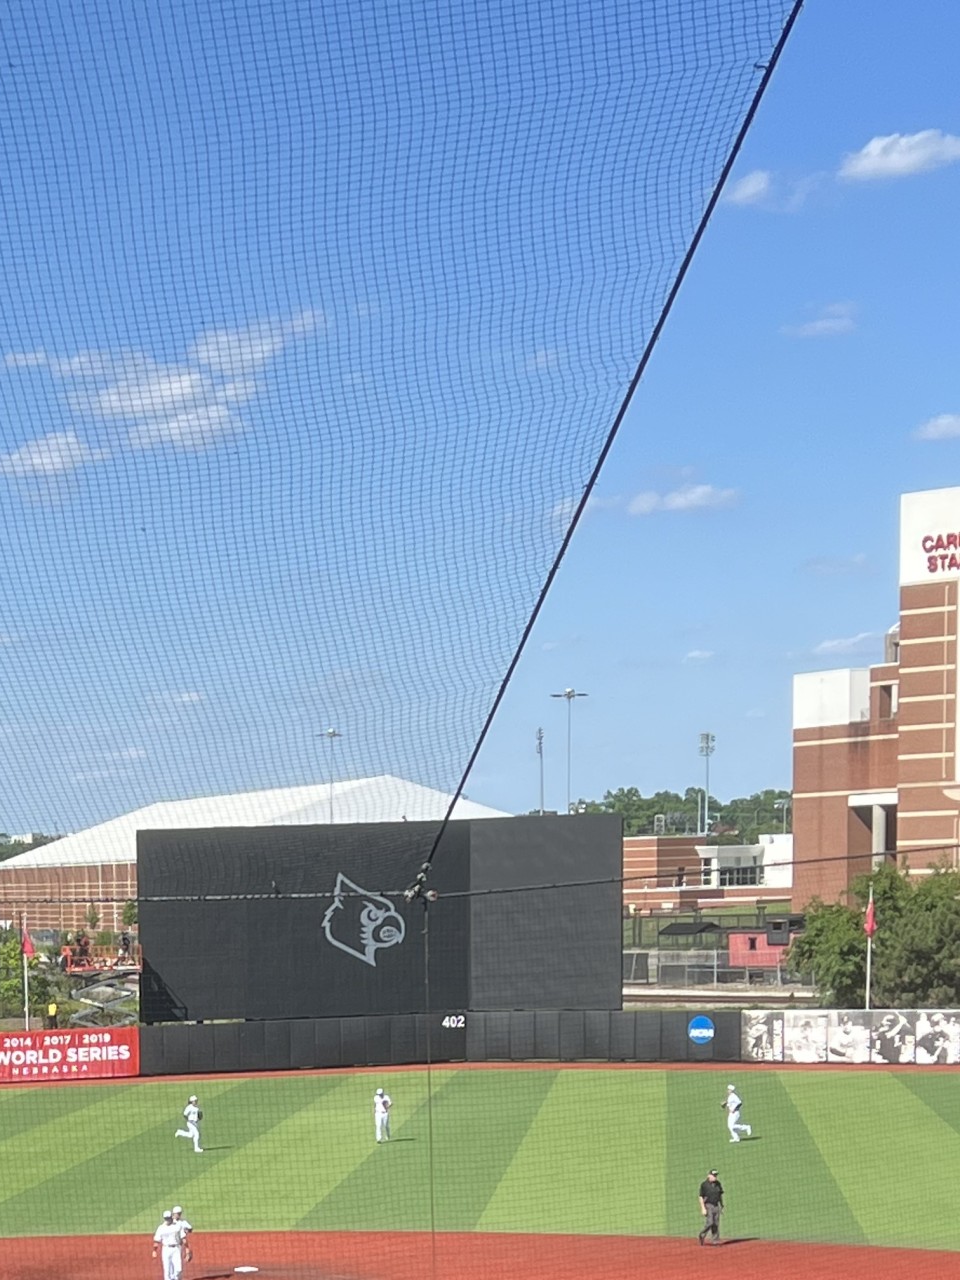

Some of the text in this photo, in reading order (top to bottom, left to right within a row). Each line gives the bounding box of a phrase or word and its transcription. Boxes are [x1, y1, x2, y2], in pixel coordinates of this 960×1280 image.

[922, 532, 960, 553] CAR
[441, 1015, 465, 1028] 402
[3, 1036, 32, 1048] 2014
[43, 1034, 72, 1046] 2017
[82, 1032, 112, 1044] 2019
[66, 1044, 131, 1063] SERIES
[11, 1064, 88, 1076] NEBRASKA
